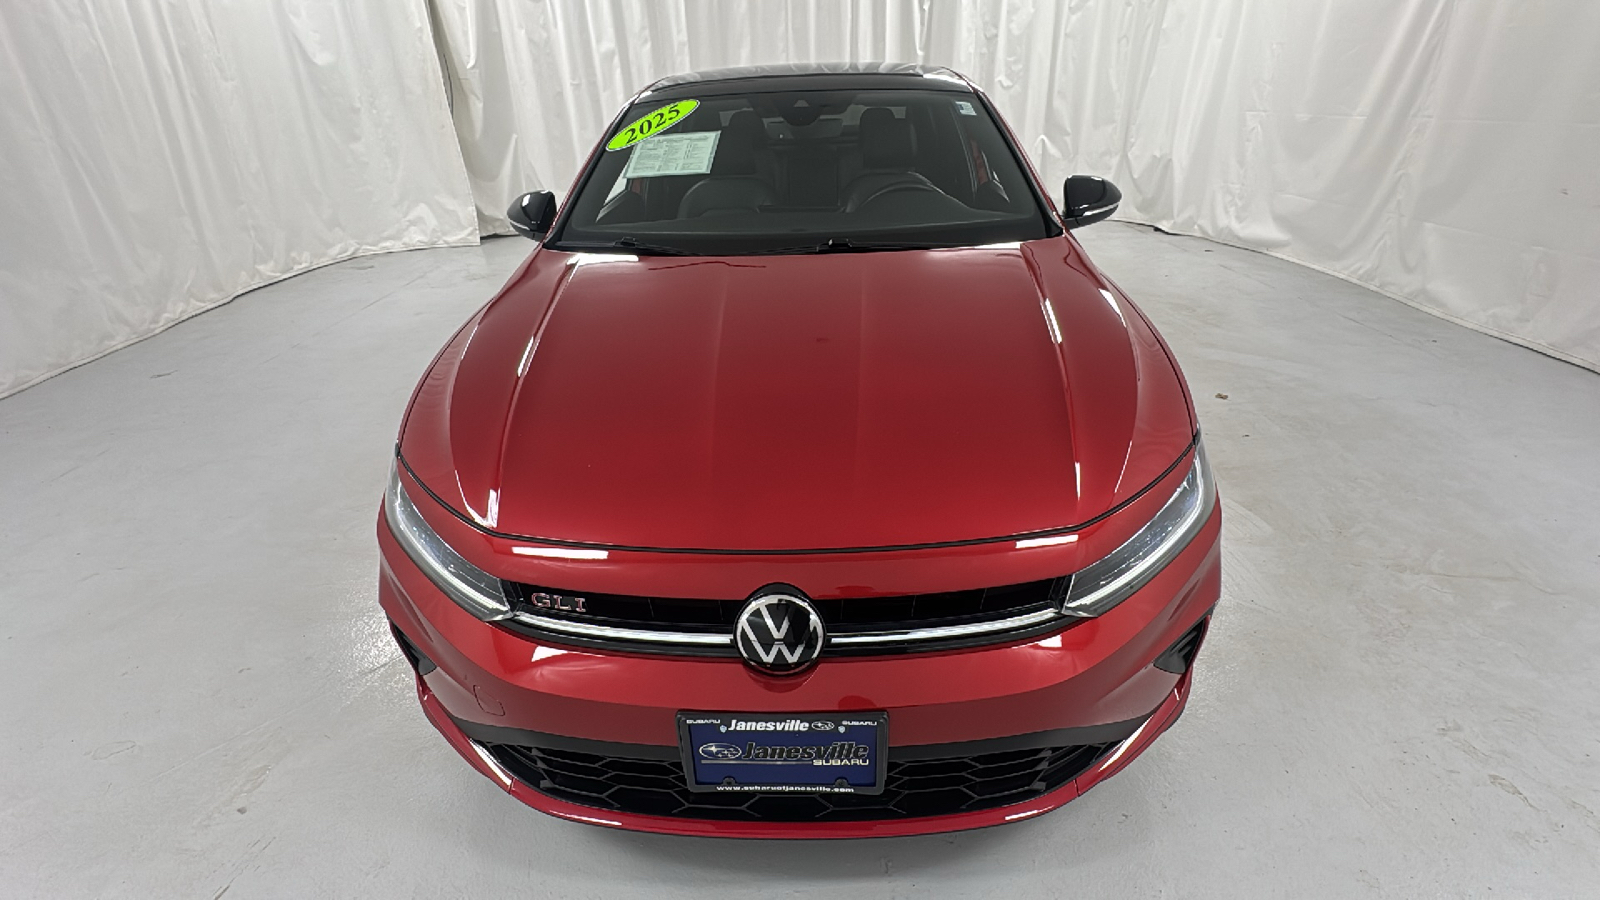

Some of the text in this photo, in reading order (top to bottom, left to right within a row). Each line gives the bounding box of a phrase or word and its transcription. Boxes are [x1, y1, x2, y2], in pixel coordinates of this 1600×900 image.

[625, 104, 680, 144] 2025
[532, 593, 586, 612] GLI
[728, 719, 809, 731] Janesville
[742, 741, 869, 760] Janesville
